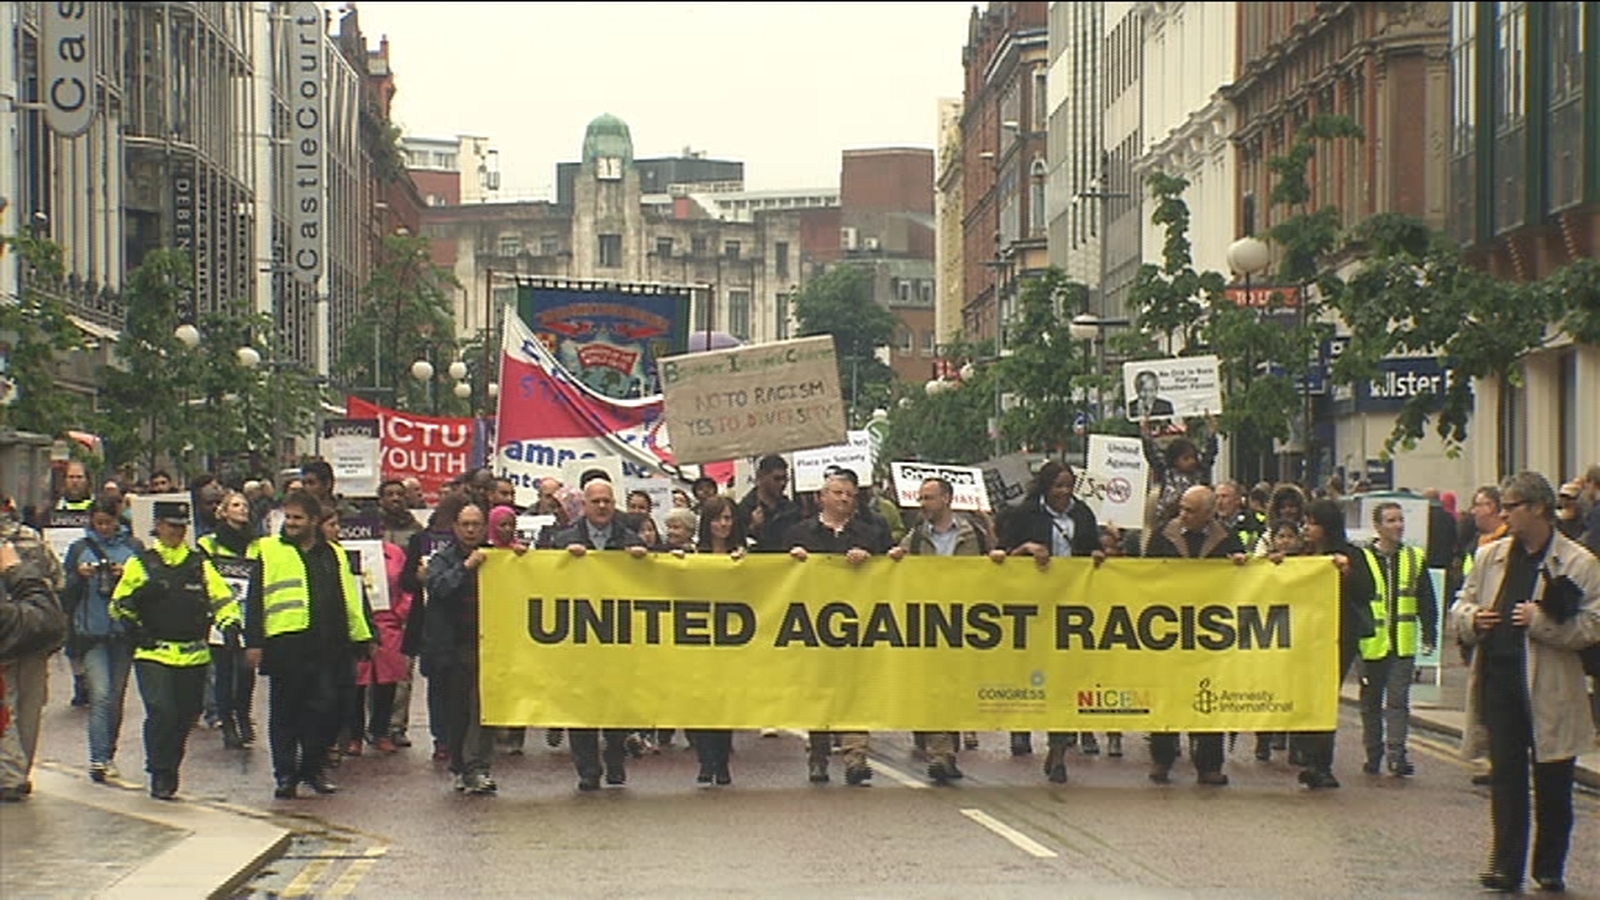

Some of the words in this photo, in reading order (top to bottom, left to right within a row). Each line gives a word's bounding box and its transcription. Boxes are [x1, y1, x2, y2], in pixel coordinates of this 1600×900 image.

[296, 14, 318, 271] CastleCourt
[726, 389, 748, 408] TO
[754, 380, 825, 404] RACISM
[378, 412, 467, 447] ICTU
[686, 418, 714, 437] YES
[718, 415, 740, 433] TO
[528, 597, 757, 645] UNITED
[774, 602, 1038, 650] AGAINST
[1055, 604, 1292, 651] RACISM
[977, 688, 1046, 700] CONGRESS
[1219, 690, 1274, 703] Amnesty
[1219, 701, 1294, 713] International
